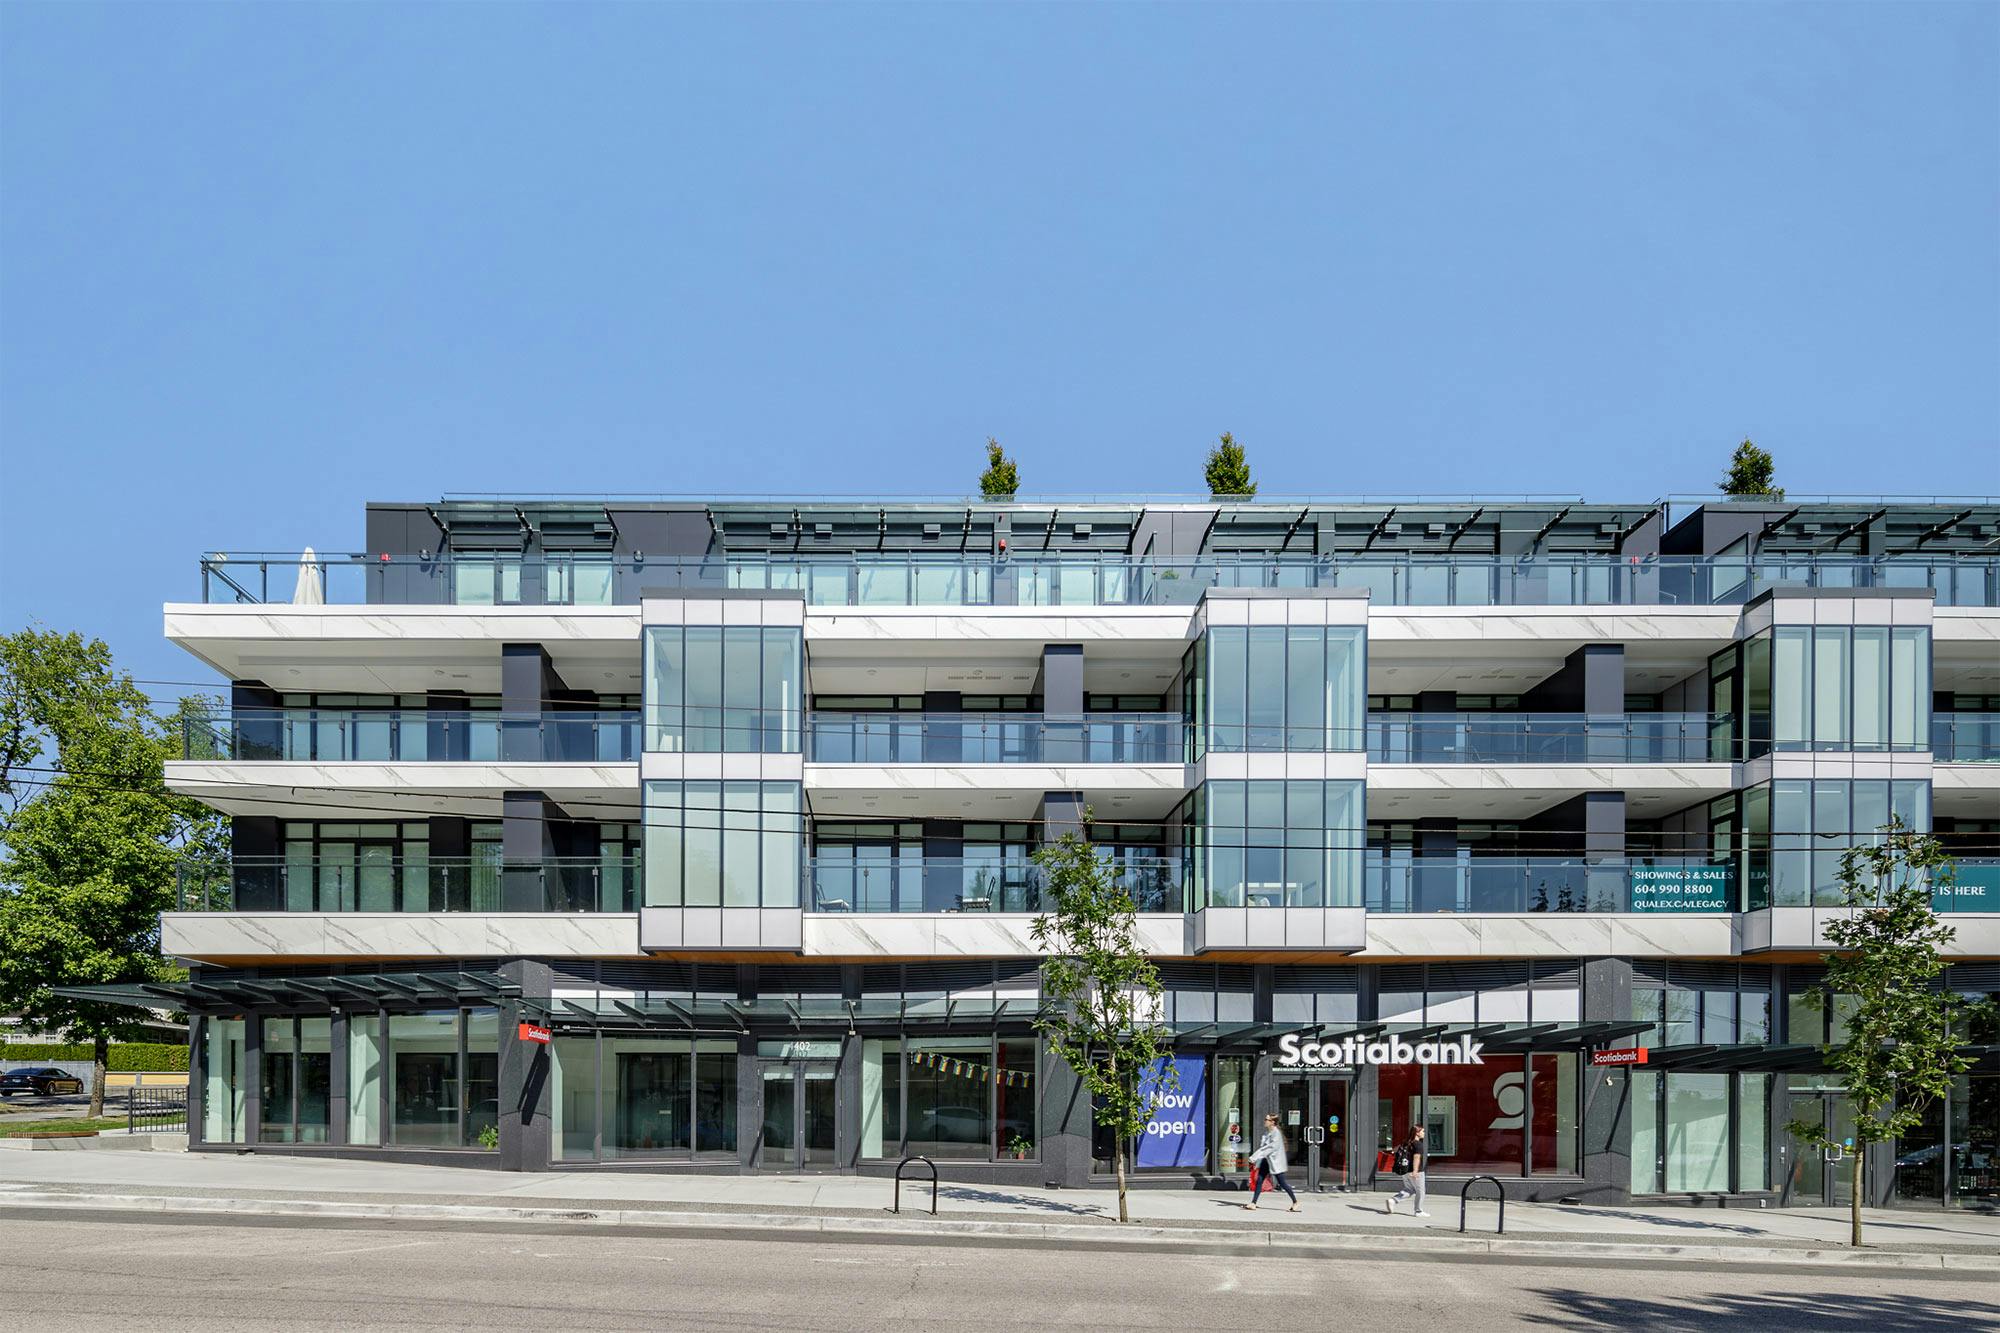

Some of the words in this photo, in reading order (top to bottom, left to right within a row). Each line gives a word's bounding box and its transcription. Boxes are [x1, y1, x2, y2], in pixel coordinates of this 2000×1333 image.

[1634, 871, 1690, 880] SHOWINGS
[1692, 871, 1701, 880] &
[1703, 871, 1734, 880] SALES
[1634, 884, 1656, 894] 604
[1659, 884, 1680, 894] 990
[1684, 884, 1713, 894] 8800
[1940, 886, 1951, 896] IS
[1955, 886, 1986, 896] HERE
[1634, 900, 1729, 909] QUALEX.CA/LEGACY
[1278, 1034, 1485, 1065] Scotiabank
[1594, 1051, 1637, 1062] Scotiabank
[1149, 1090, 1193, 1109] Now
[1146, 1121, 1196, 1139] open
